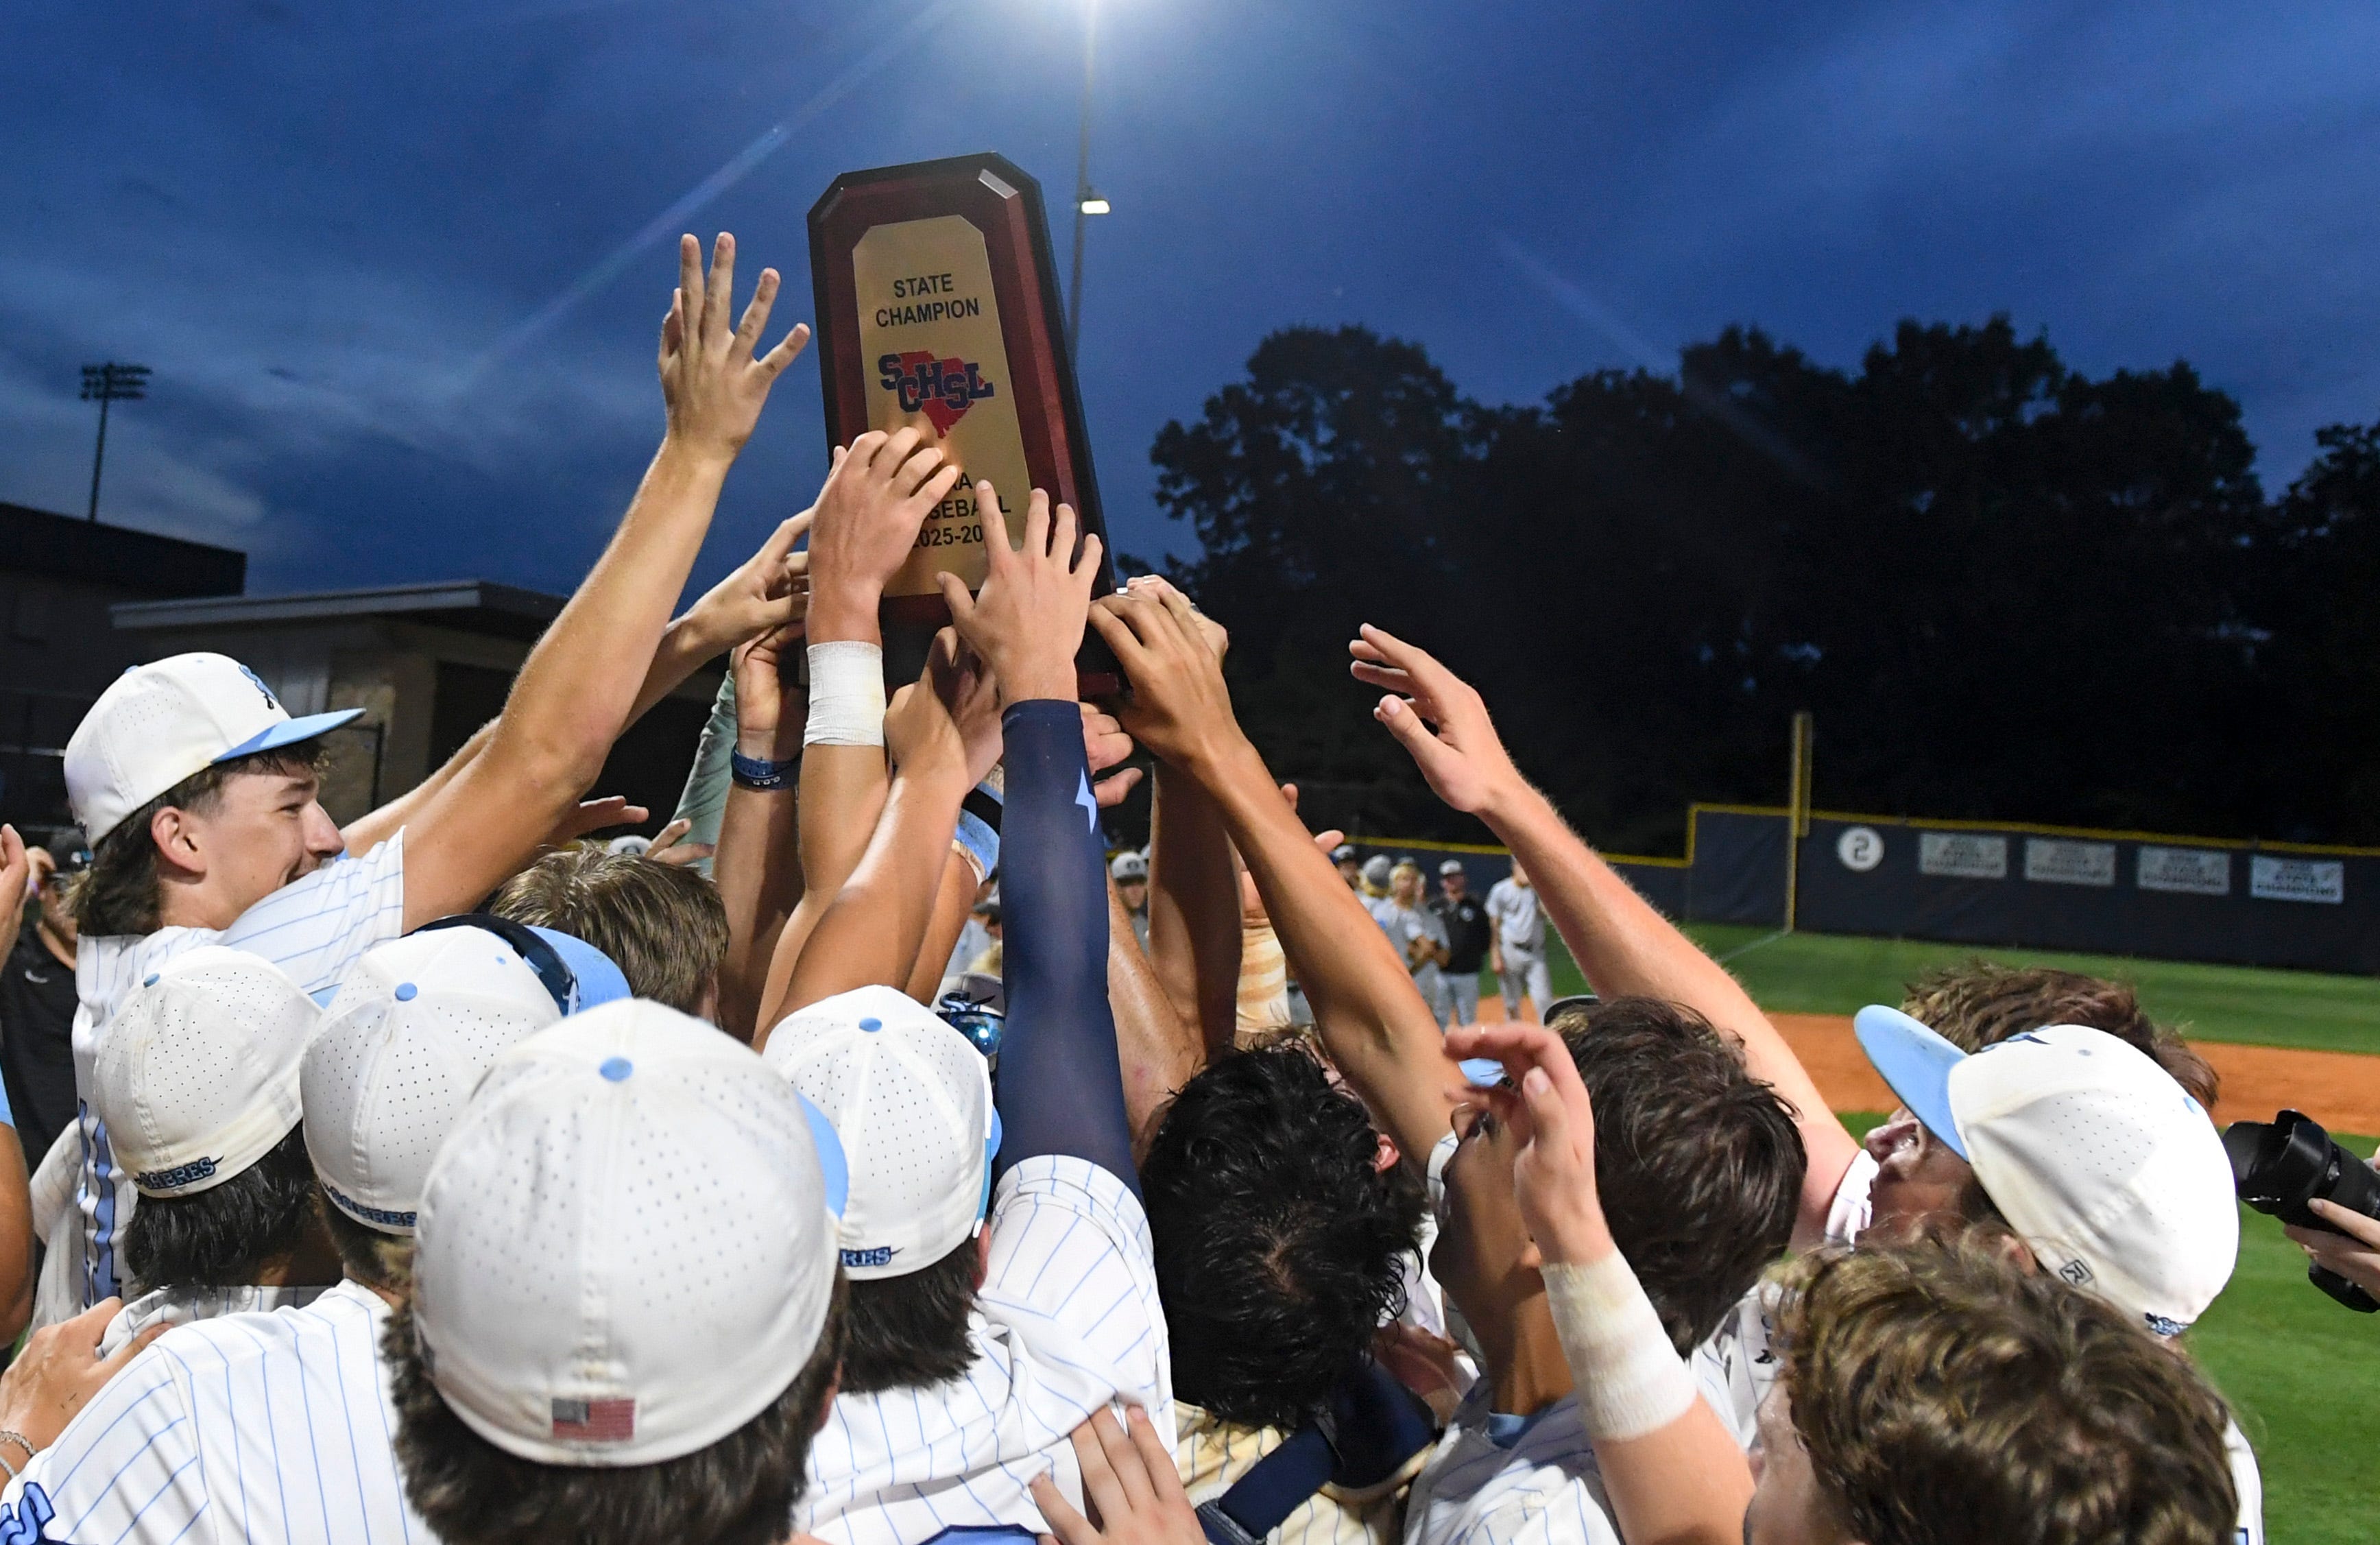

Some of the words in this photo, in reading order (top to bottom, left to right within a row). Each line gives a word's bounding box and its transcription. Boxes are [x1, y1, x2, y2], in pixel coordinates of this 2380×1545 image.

[893, 273, 954, 298] STATE
[876, 298, 979, 327] CHAMPION
[878, 354, 994, 413] SCHSL
[913, 525, 983, 548] 025-20
[1854, 835, 1870, 862] 2
[139, 1156, 217, 1190] SABRES
